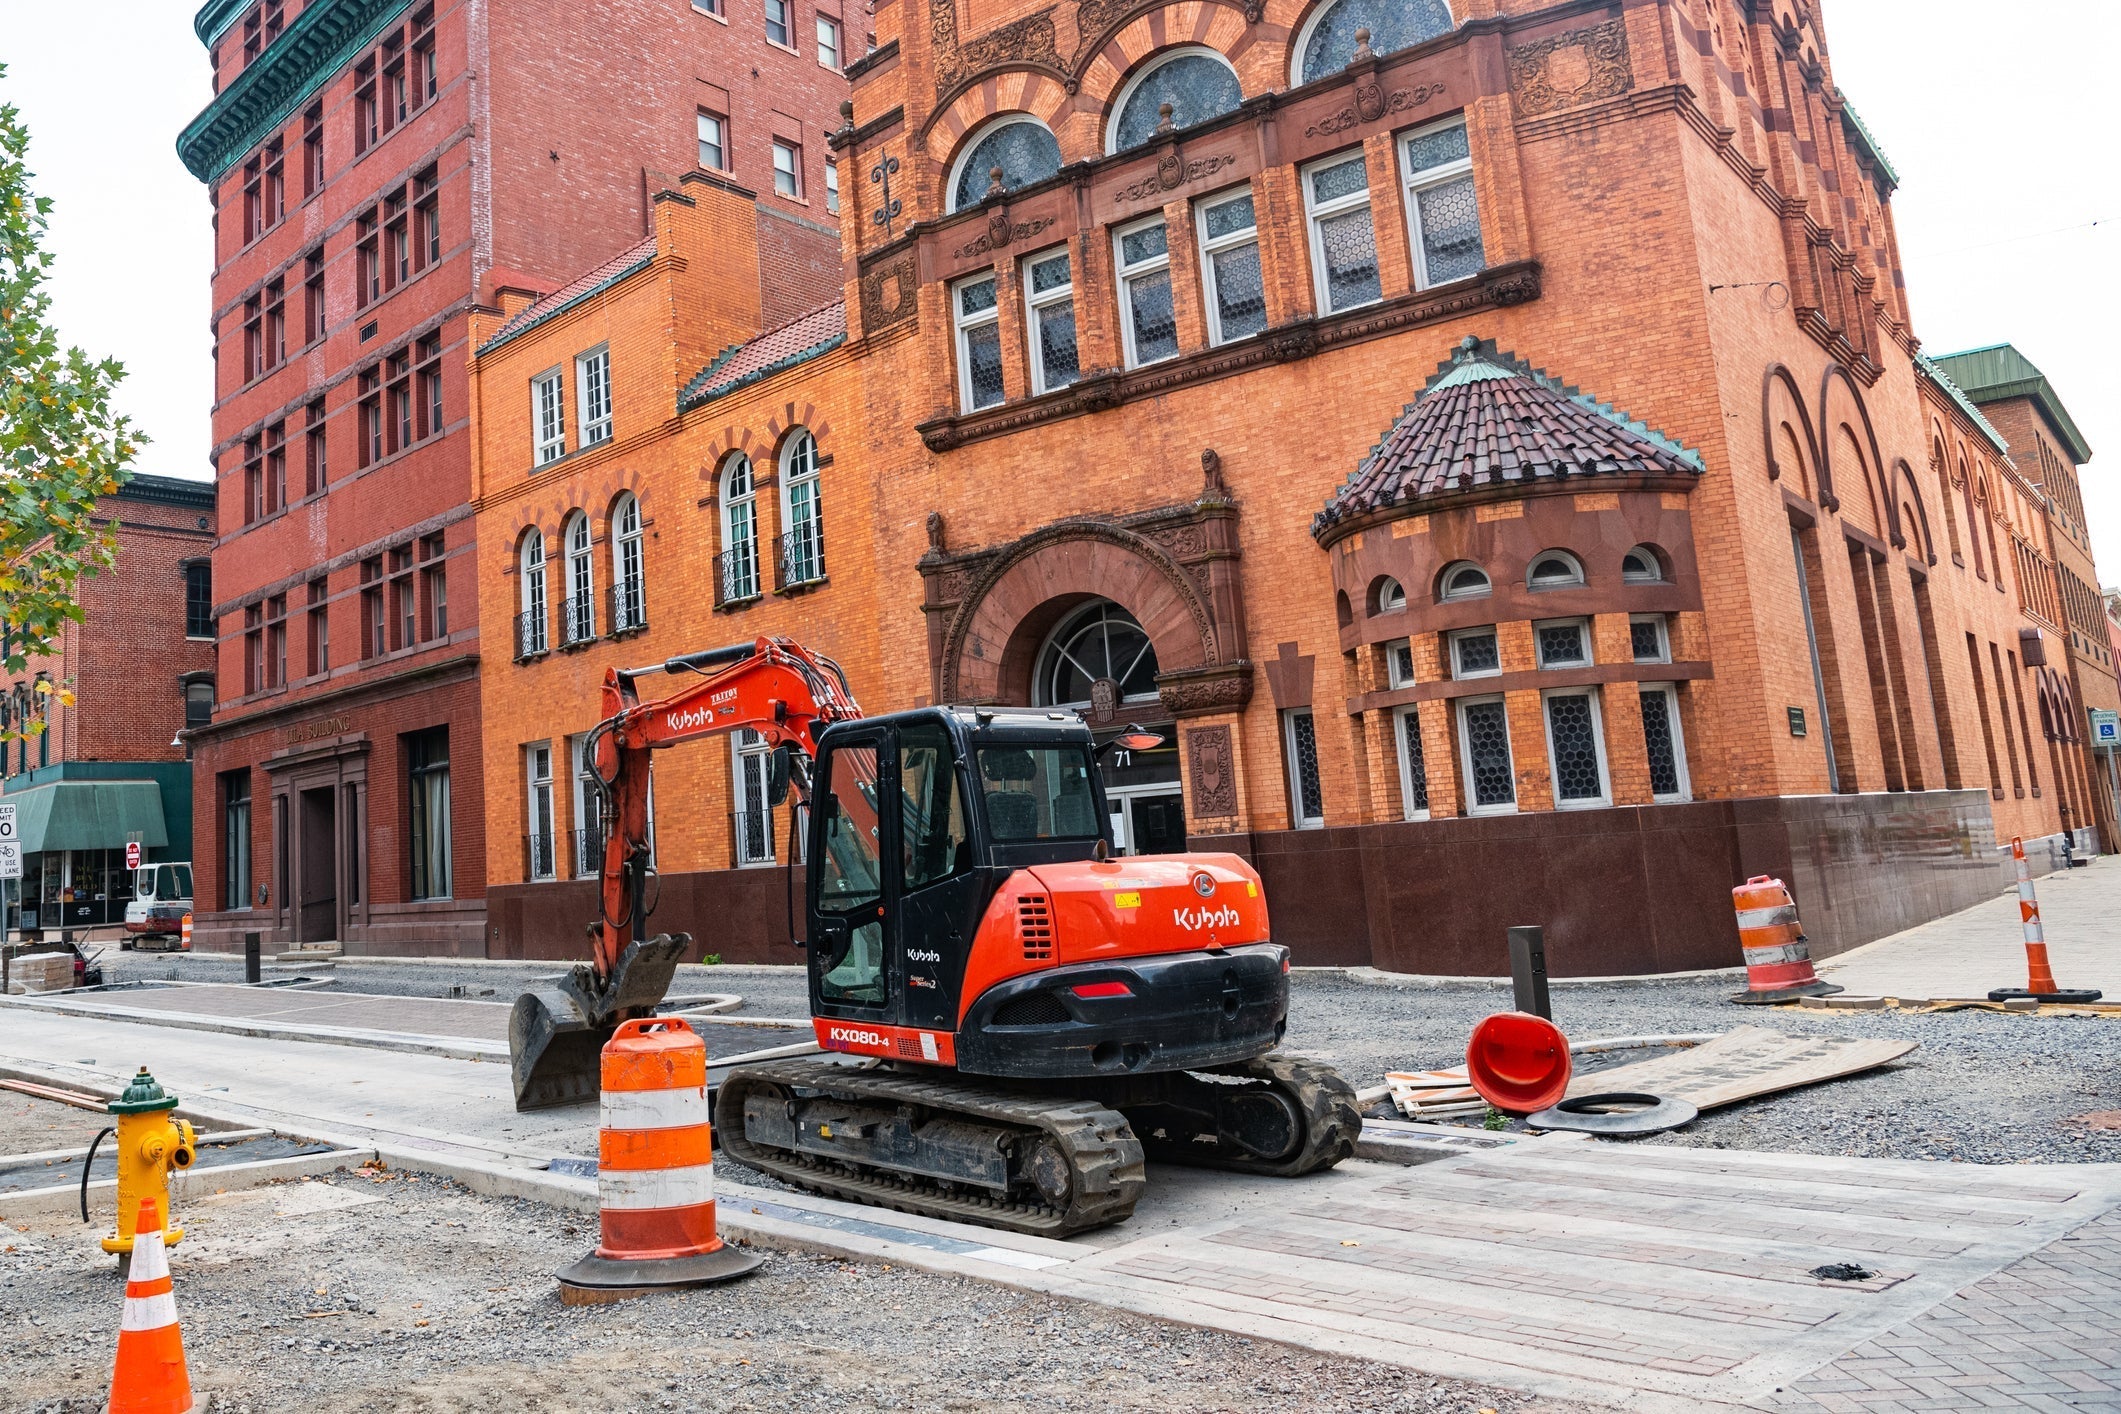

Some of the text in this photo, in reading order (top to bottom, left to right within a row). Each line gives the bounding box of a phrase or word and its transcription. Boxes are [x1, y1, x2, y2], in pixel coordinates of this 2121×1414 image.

[306, 715, 350, 739] BUILDING
[667, 706, 714, 730] Kubota
[1114, 750, 1131, 767] 71
[1173, 904, 1240, 931] Kubota
[907, 948, 940, 962] Kubota
[830, 1027, 890, 1047] KX080-4
